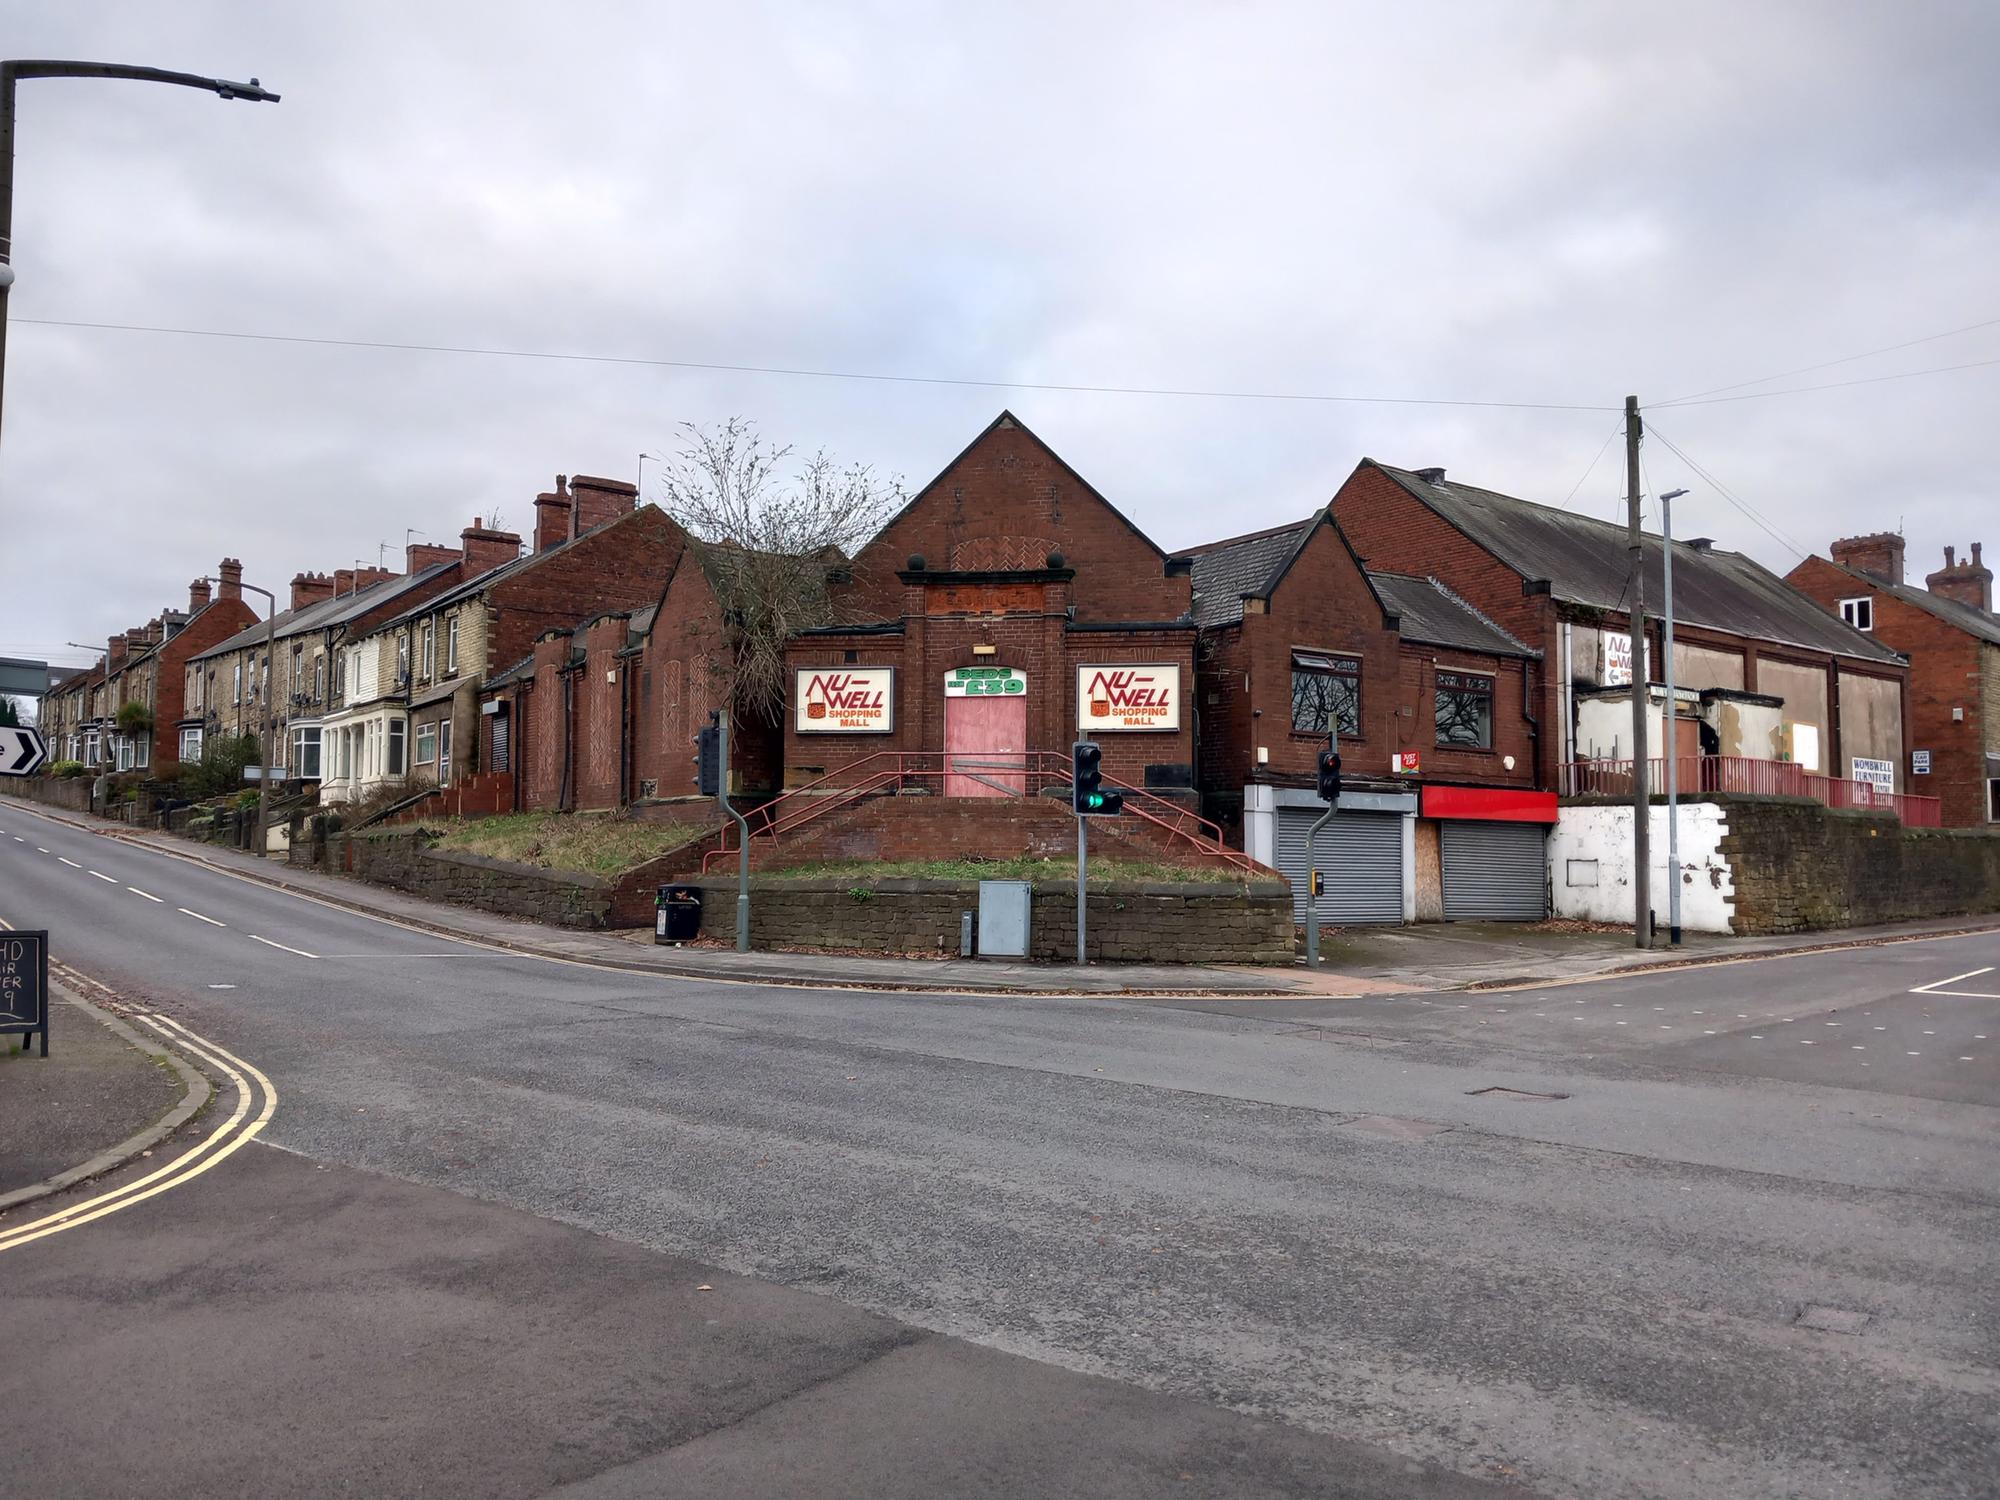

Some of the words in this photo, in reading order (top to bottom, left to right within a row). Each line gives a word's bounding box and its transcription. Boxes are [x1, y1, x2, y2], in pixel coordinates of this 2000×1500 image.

[956, 669, 1012, 680] BEDS
[966, 679, 1024, 695] £39
[822, 690, 883, 709] WELL
[1107, 688, 1170, 707] WELL
[829, 709, 881, 718] SHOPPING
[1112, 707, 1168, 716] SHOPPING
[840, 718, 870, 727] MALL
[1124, 717, 1155, 726] MALL
[1854, 760, 1891, 772] WOMBWELL
[1855, 771, 1892, 784] FURNITURE
